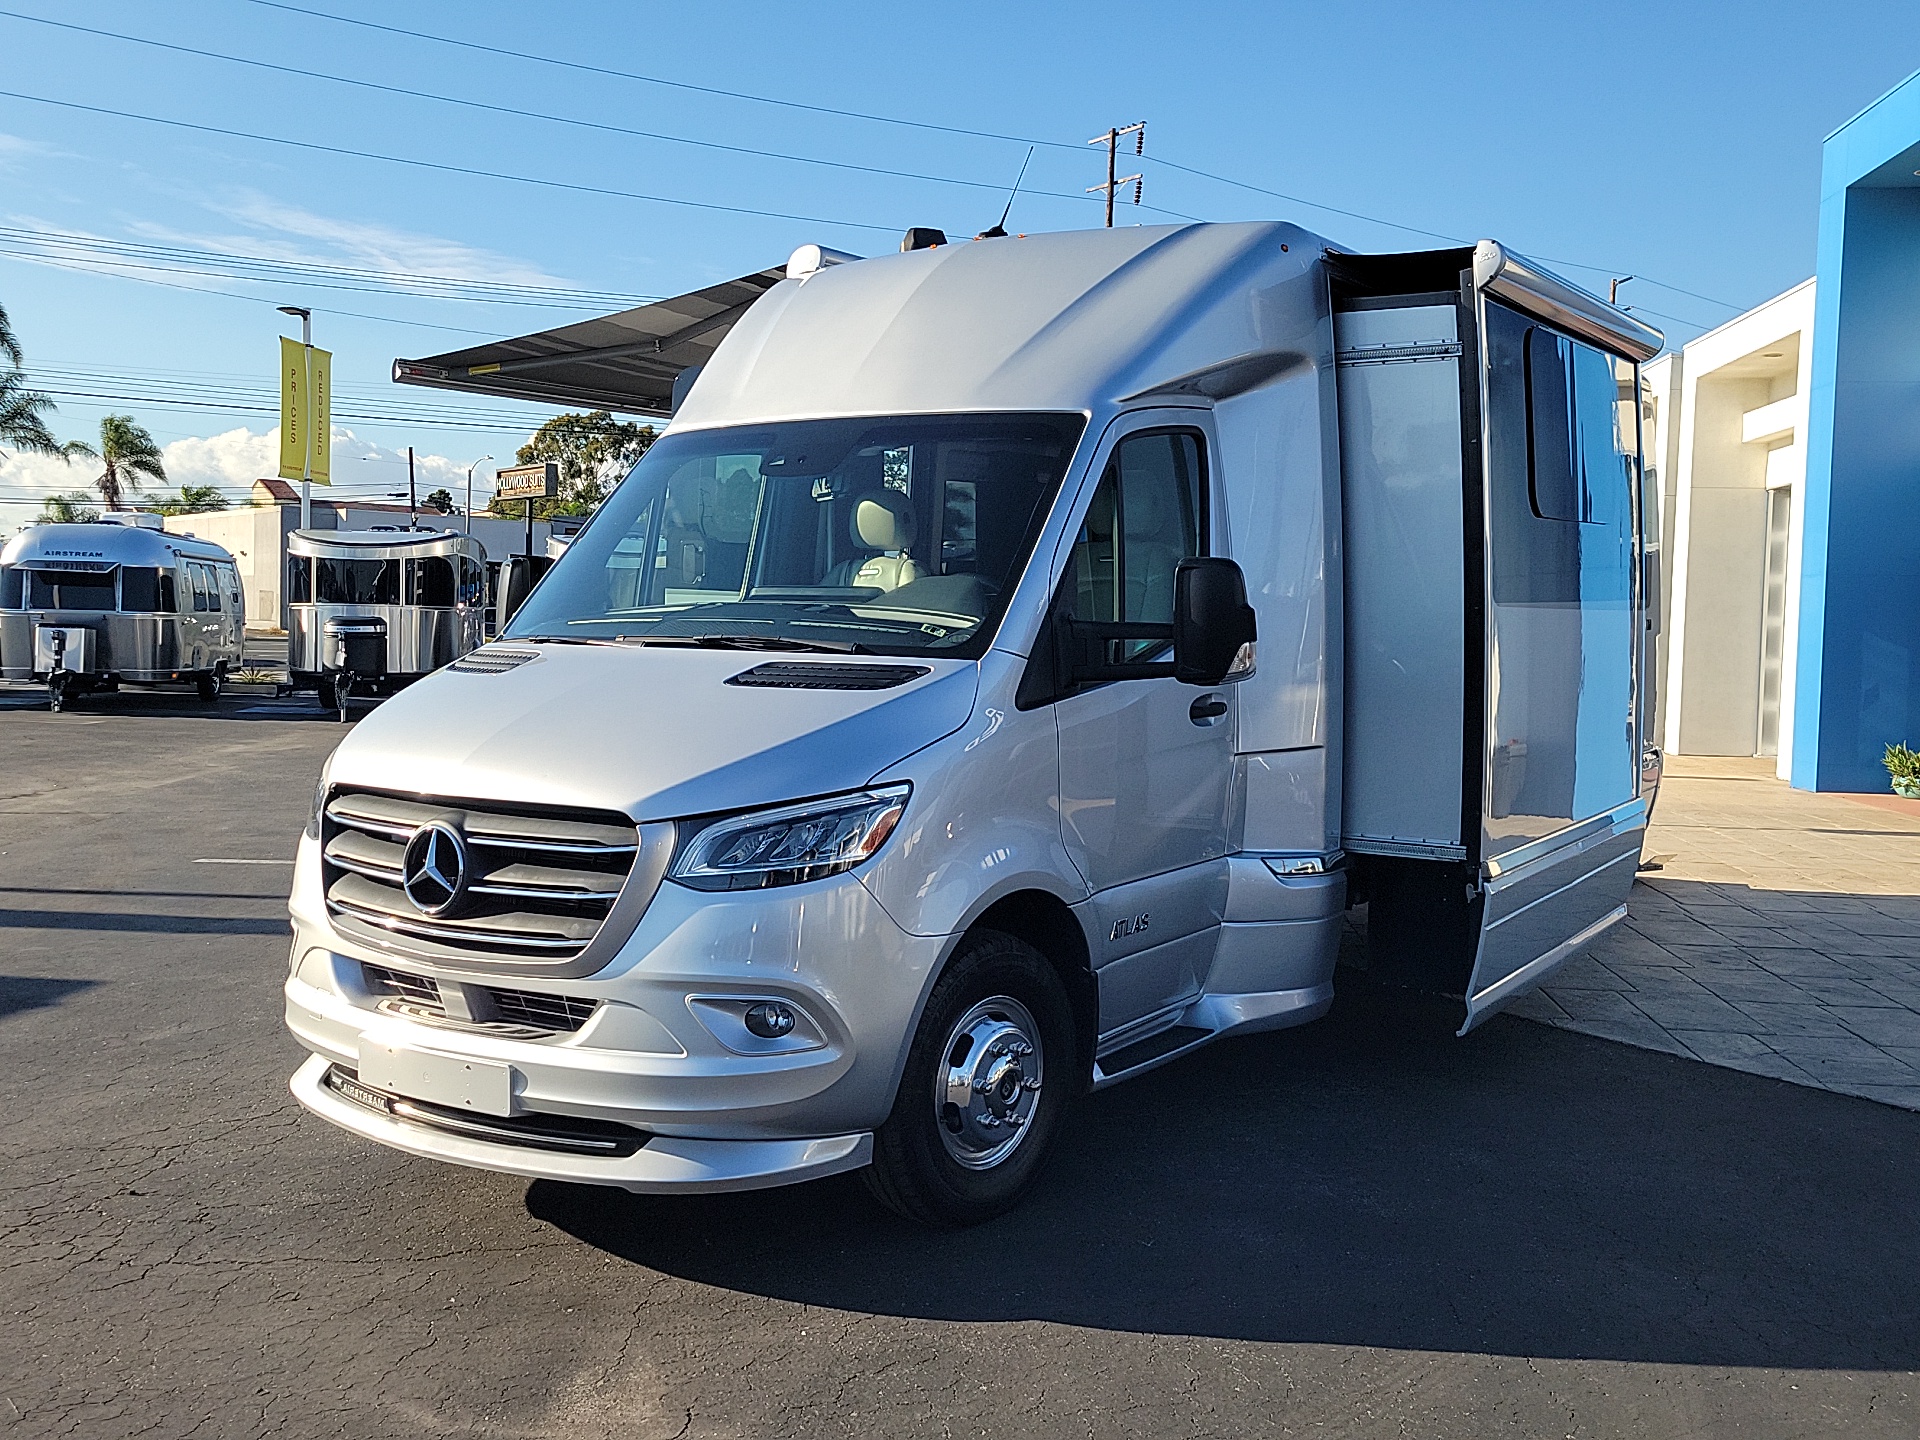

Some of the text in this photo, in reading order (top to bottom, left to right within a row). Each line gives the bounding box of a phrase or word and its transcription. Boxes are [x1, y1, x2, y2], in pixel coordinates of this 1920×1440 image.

[496, 473, 545, 491] HOLLYWOOD SUITS
[44, 550, 103, 558] AIRSTREAM
[1109, 912, 1150, 942] ATLAS
[340, 1083, 385, 1109] AIRSTREAM
